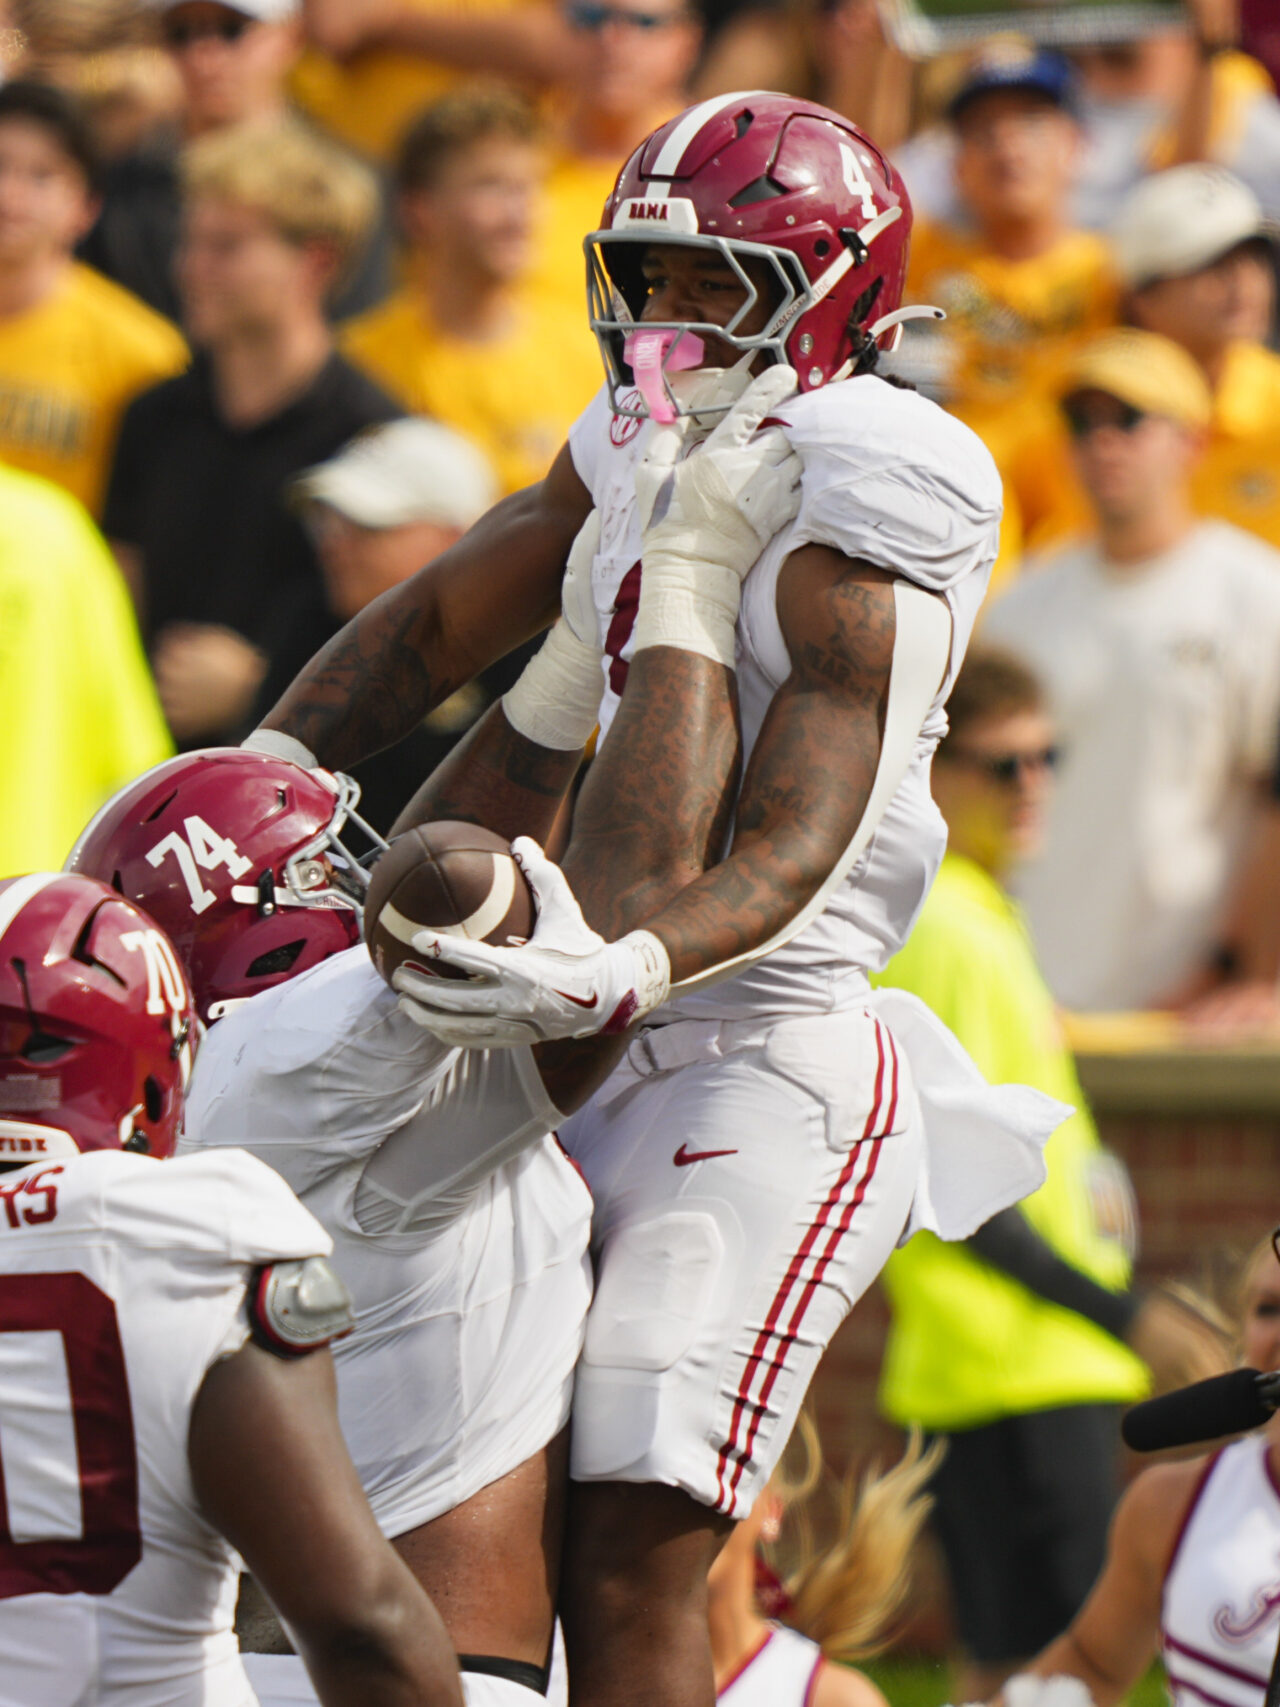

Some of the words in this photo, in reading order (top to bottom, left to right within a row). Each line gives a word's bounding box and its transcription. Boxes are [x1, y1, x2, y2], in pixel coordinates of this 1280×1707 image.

[628, 203, 668, 220] BAMA
[839, 142, 878, 219] 4
[145, 815, 254, 915] 74
[119, 929, 187, 1015] 70
